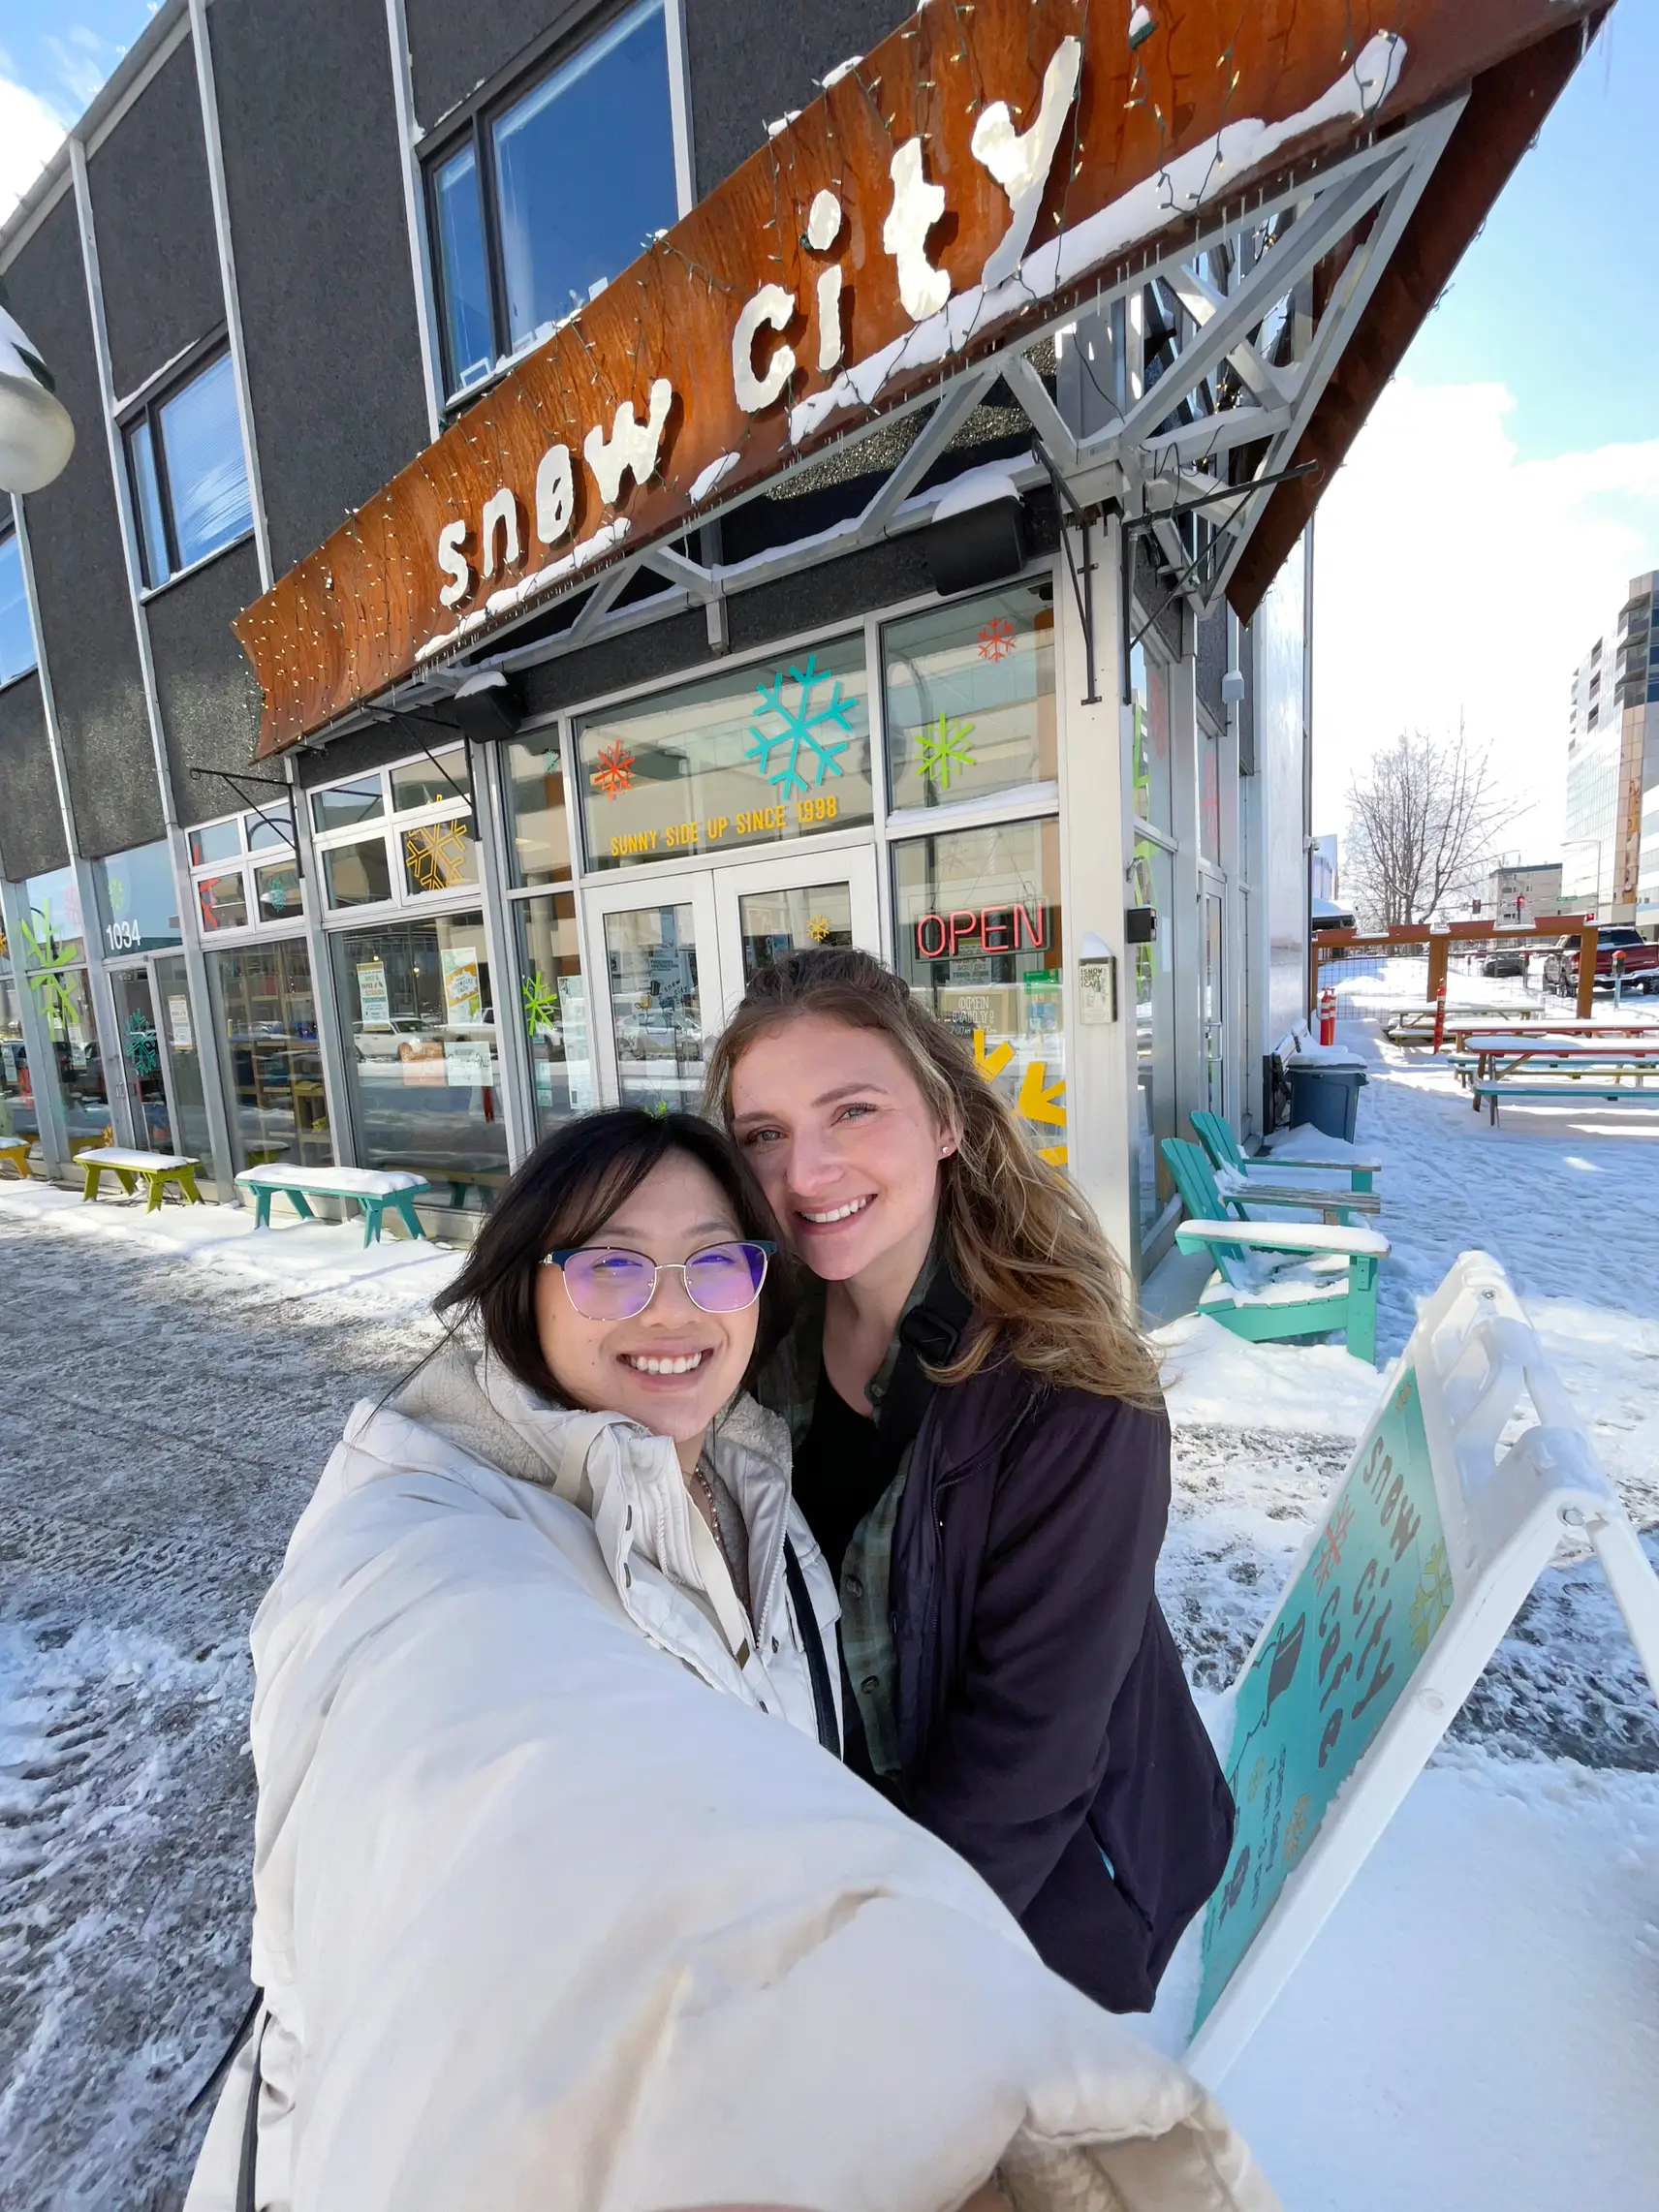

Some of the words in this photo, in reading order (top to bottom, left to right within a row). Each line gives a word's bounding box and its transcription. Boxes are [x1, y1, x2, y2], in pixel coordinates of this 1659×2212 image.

[438, 378, 673, 607] snow
[732, 35, 1080, 413] city
[610, 829, 658, 857] SUNNY
[666, 822, 699, 847] SIDE
[707, 817, 728, 839] UP
[736, 805, 786, 834] SINCE
[796, 795, 837, 823] 1998
[106, 919, 141, 950] 1034
[917, 902, 1044, 957] OPEN
[957, 996, 989, 1010] OPEN
[1362, 1436, 1421, 1562] snow
[1317, 1584, 1353, 1770] cafe
[1352, 1557, 1395, 1720] city
